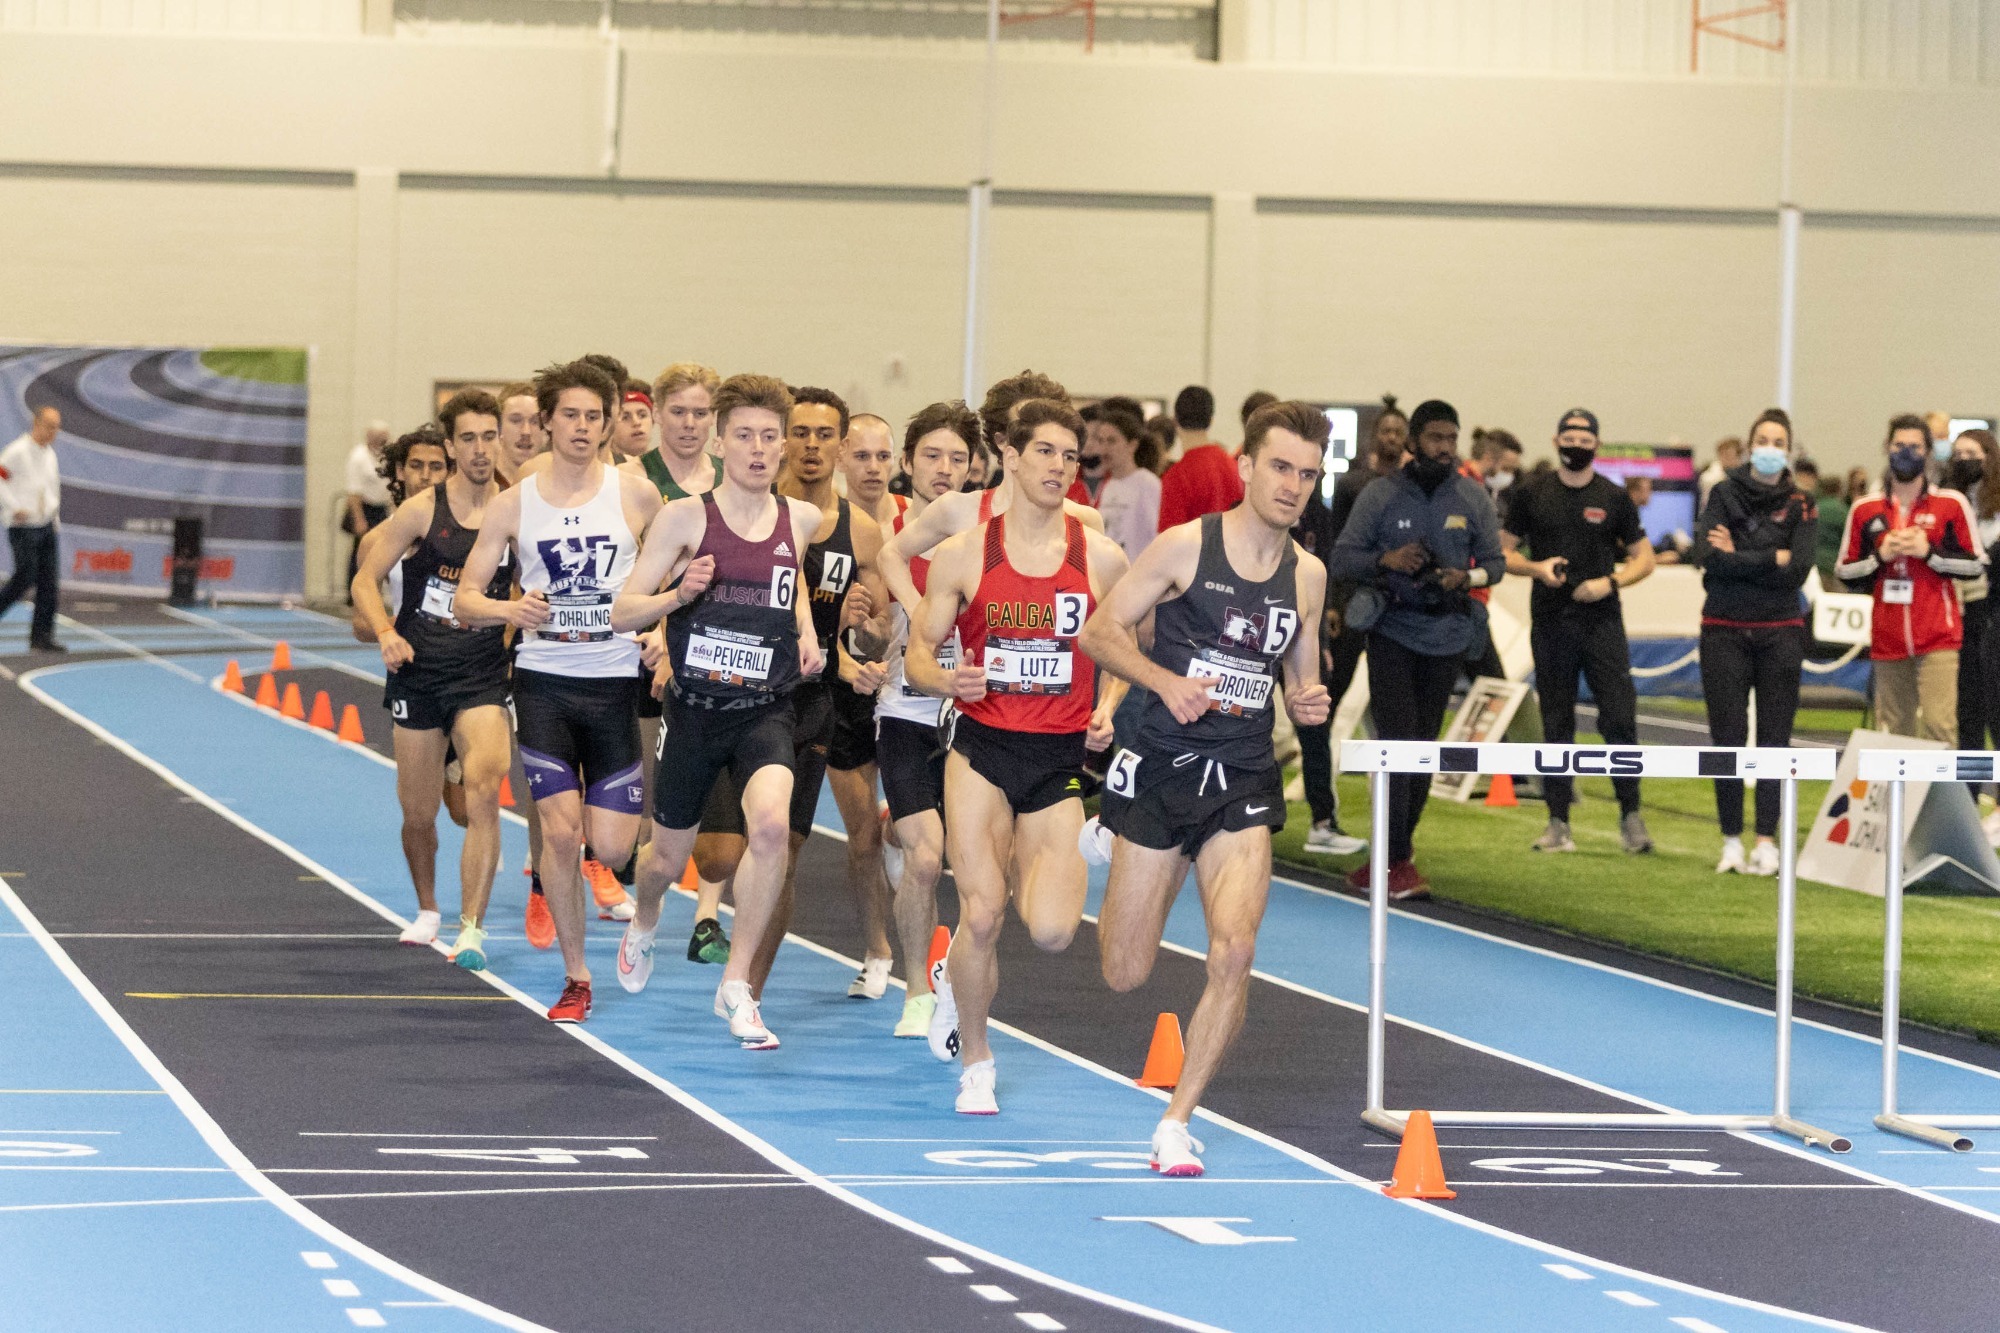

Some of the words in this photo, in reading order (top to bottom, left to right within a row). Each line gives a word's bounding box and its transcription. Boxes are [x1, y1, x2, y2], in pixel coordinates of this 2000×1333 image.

[603, 544, 618, 577] 7
[773, 549, 793, 557] adidas
[438, 564, 462, 580] GU
[826, 556, 844, 591] 4
[705, 584, 771, 607] HUSKI
[777, 569, 791, 607] 6
[1205, 581, 1235, 595] OUA
[559, 608, 610, 627] OHRLING
[986, 602, 1055, 629] CALGA
[1062, 595, 1081, 635] 3
[1827, 607, 1865, 630] 70
[1270, 611, 1291, 652] 5
[713, 645, 767, 672] PEVERILL
[1020, 657, 1059, 677] LUTZ
[1215, 673, 1269, 701] DROVER
[1113, 752, 1134, 792] 5
[1534, 750, 1644, 775] UCS
